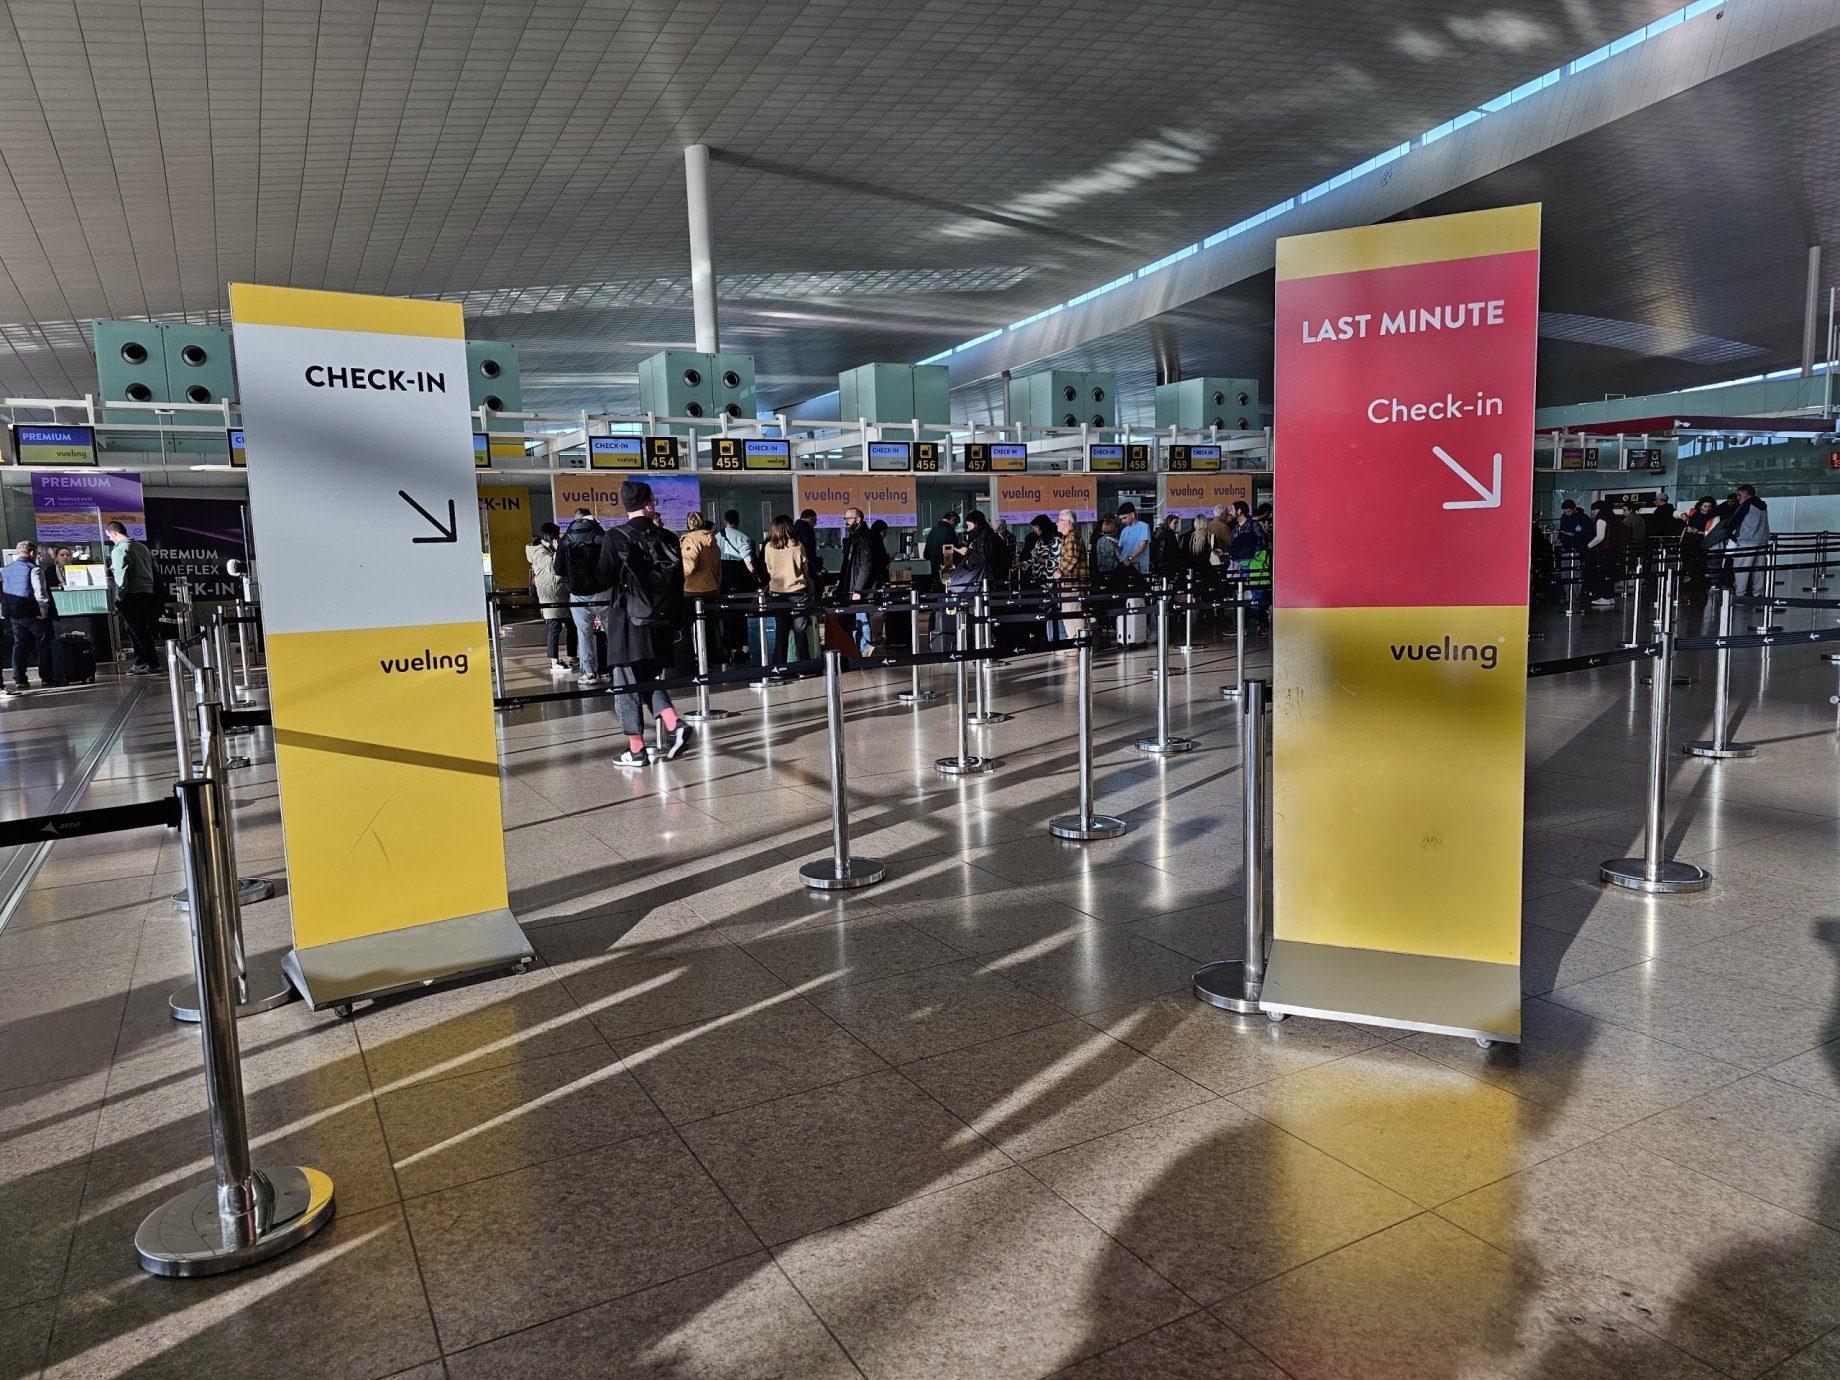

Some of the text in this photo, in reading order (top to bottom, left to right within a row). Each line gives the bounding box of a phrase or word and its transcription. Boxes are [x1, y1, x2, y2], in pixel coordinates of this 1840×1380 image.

[1302, 299, 1505, 344] LAST MINUTE
[305, 365, 446, 393] CHECK-IN
[1367, 391, 1504, 425] Check-in
[22, 432, 72, 441] PREMIUM
[56, 450, 87, 458] vueling
[616, 456, 638, 464] vueling
[651, 457, 676, 468] 454
[716, 457, 739, 468] 455
[916, 460, 936, 470] 456
[968, 460, 986, 470] 457
[1129, 460, 1146, 469] 458
[1171, 460, 1188, 469] 459
[41, 477, 111, 488] PREMIUM
[562, 486, 619, 506] vueling
[804, 486, 850, 505] vueling
[864, 486, 908, 504] vueling
[1002, 485, 1041, 502] vueling
[1052, 485, 1090, 501] vueling
[1170, 484, 1204, 499] vueling
[1213, 484, 1246, 498] vueling
[110, 514, 136, 522] vueling
[151, 549, 219, 560] PREMIUM
[159, 564, 220, 575] IMEFLEX
[1390, 635, 1498, 670] vueling
[380, 648, 469, 675] vueling
